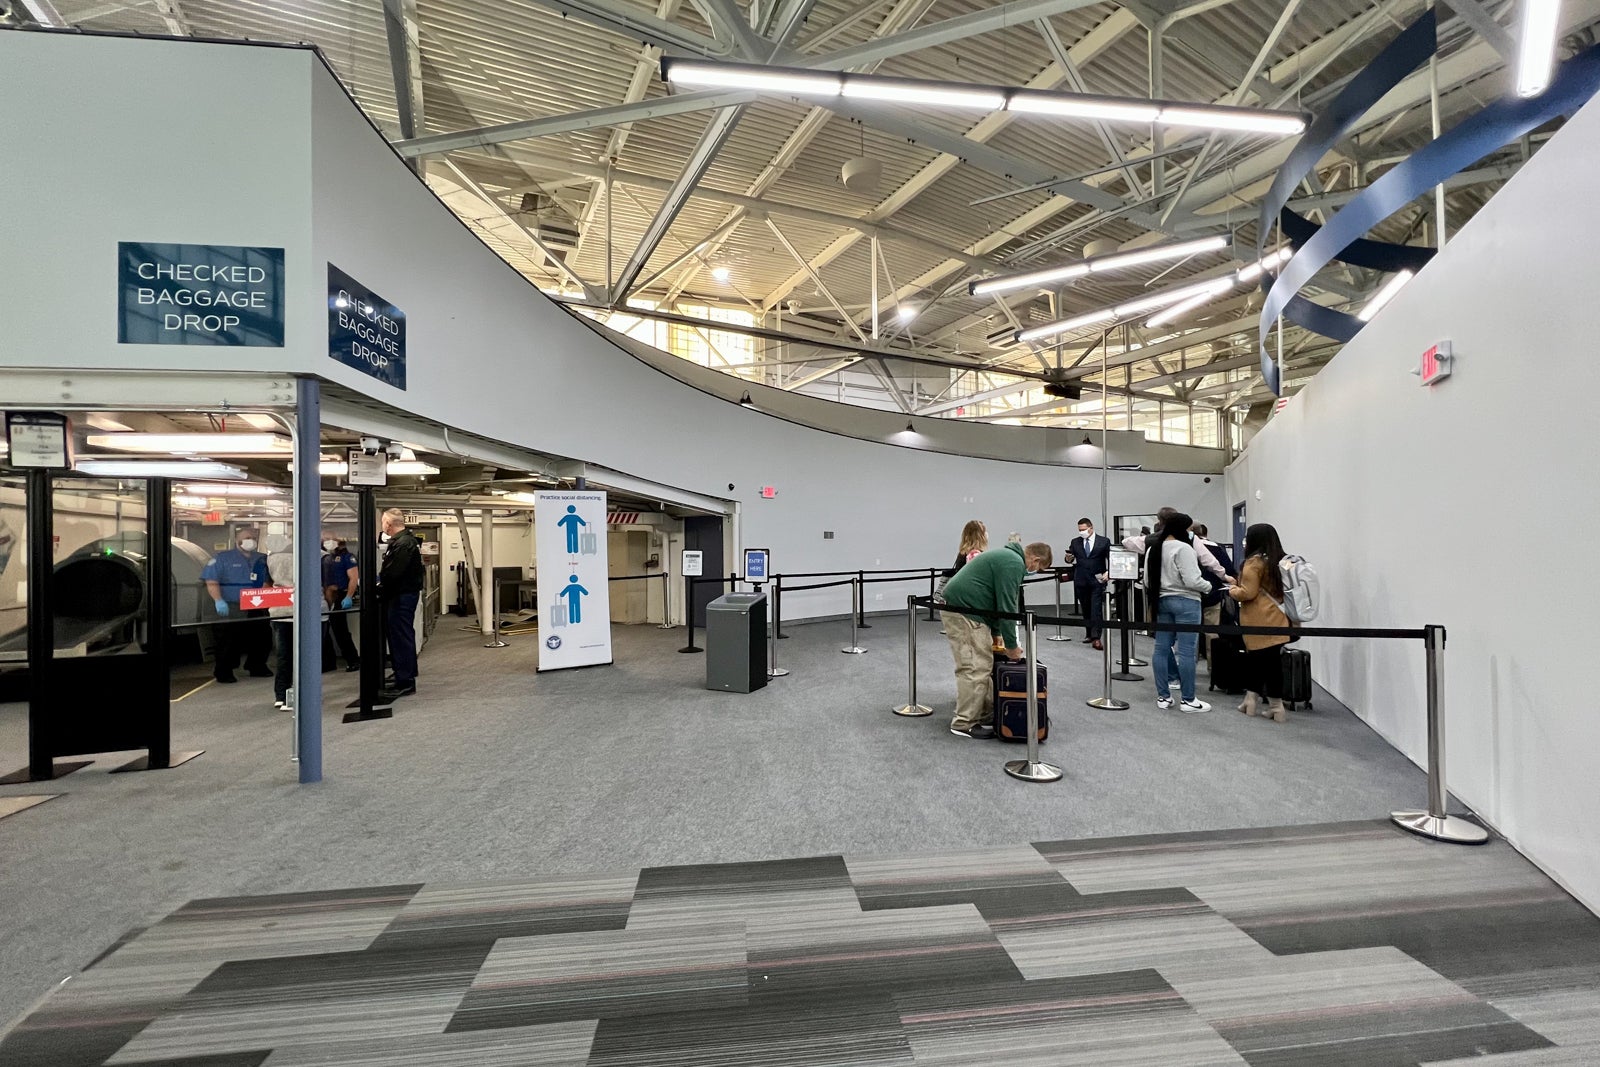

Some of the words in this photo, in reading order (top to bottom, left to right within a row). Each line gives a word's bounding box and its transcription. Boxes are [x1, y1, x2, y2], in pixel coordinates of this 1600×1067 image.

[137, 262, 266, 283] CHECKED
[137, 288, 266, 308] BAGGAGE
[164, 314, 240, 332] DROP
[338, 312, 399, 357] BAGGAGE
[352, 341, 388, 369] DROP
[403, 515, 418, 523] EXIT
